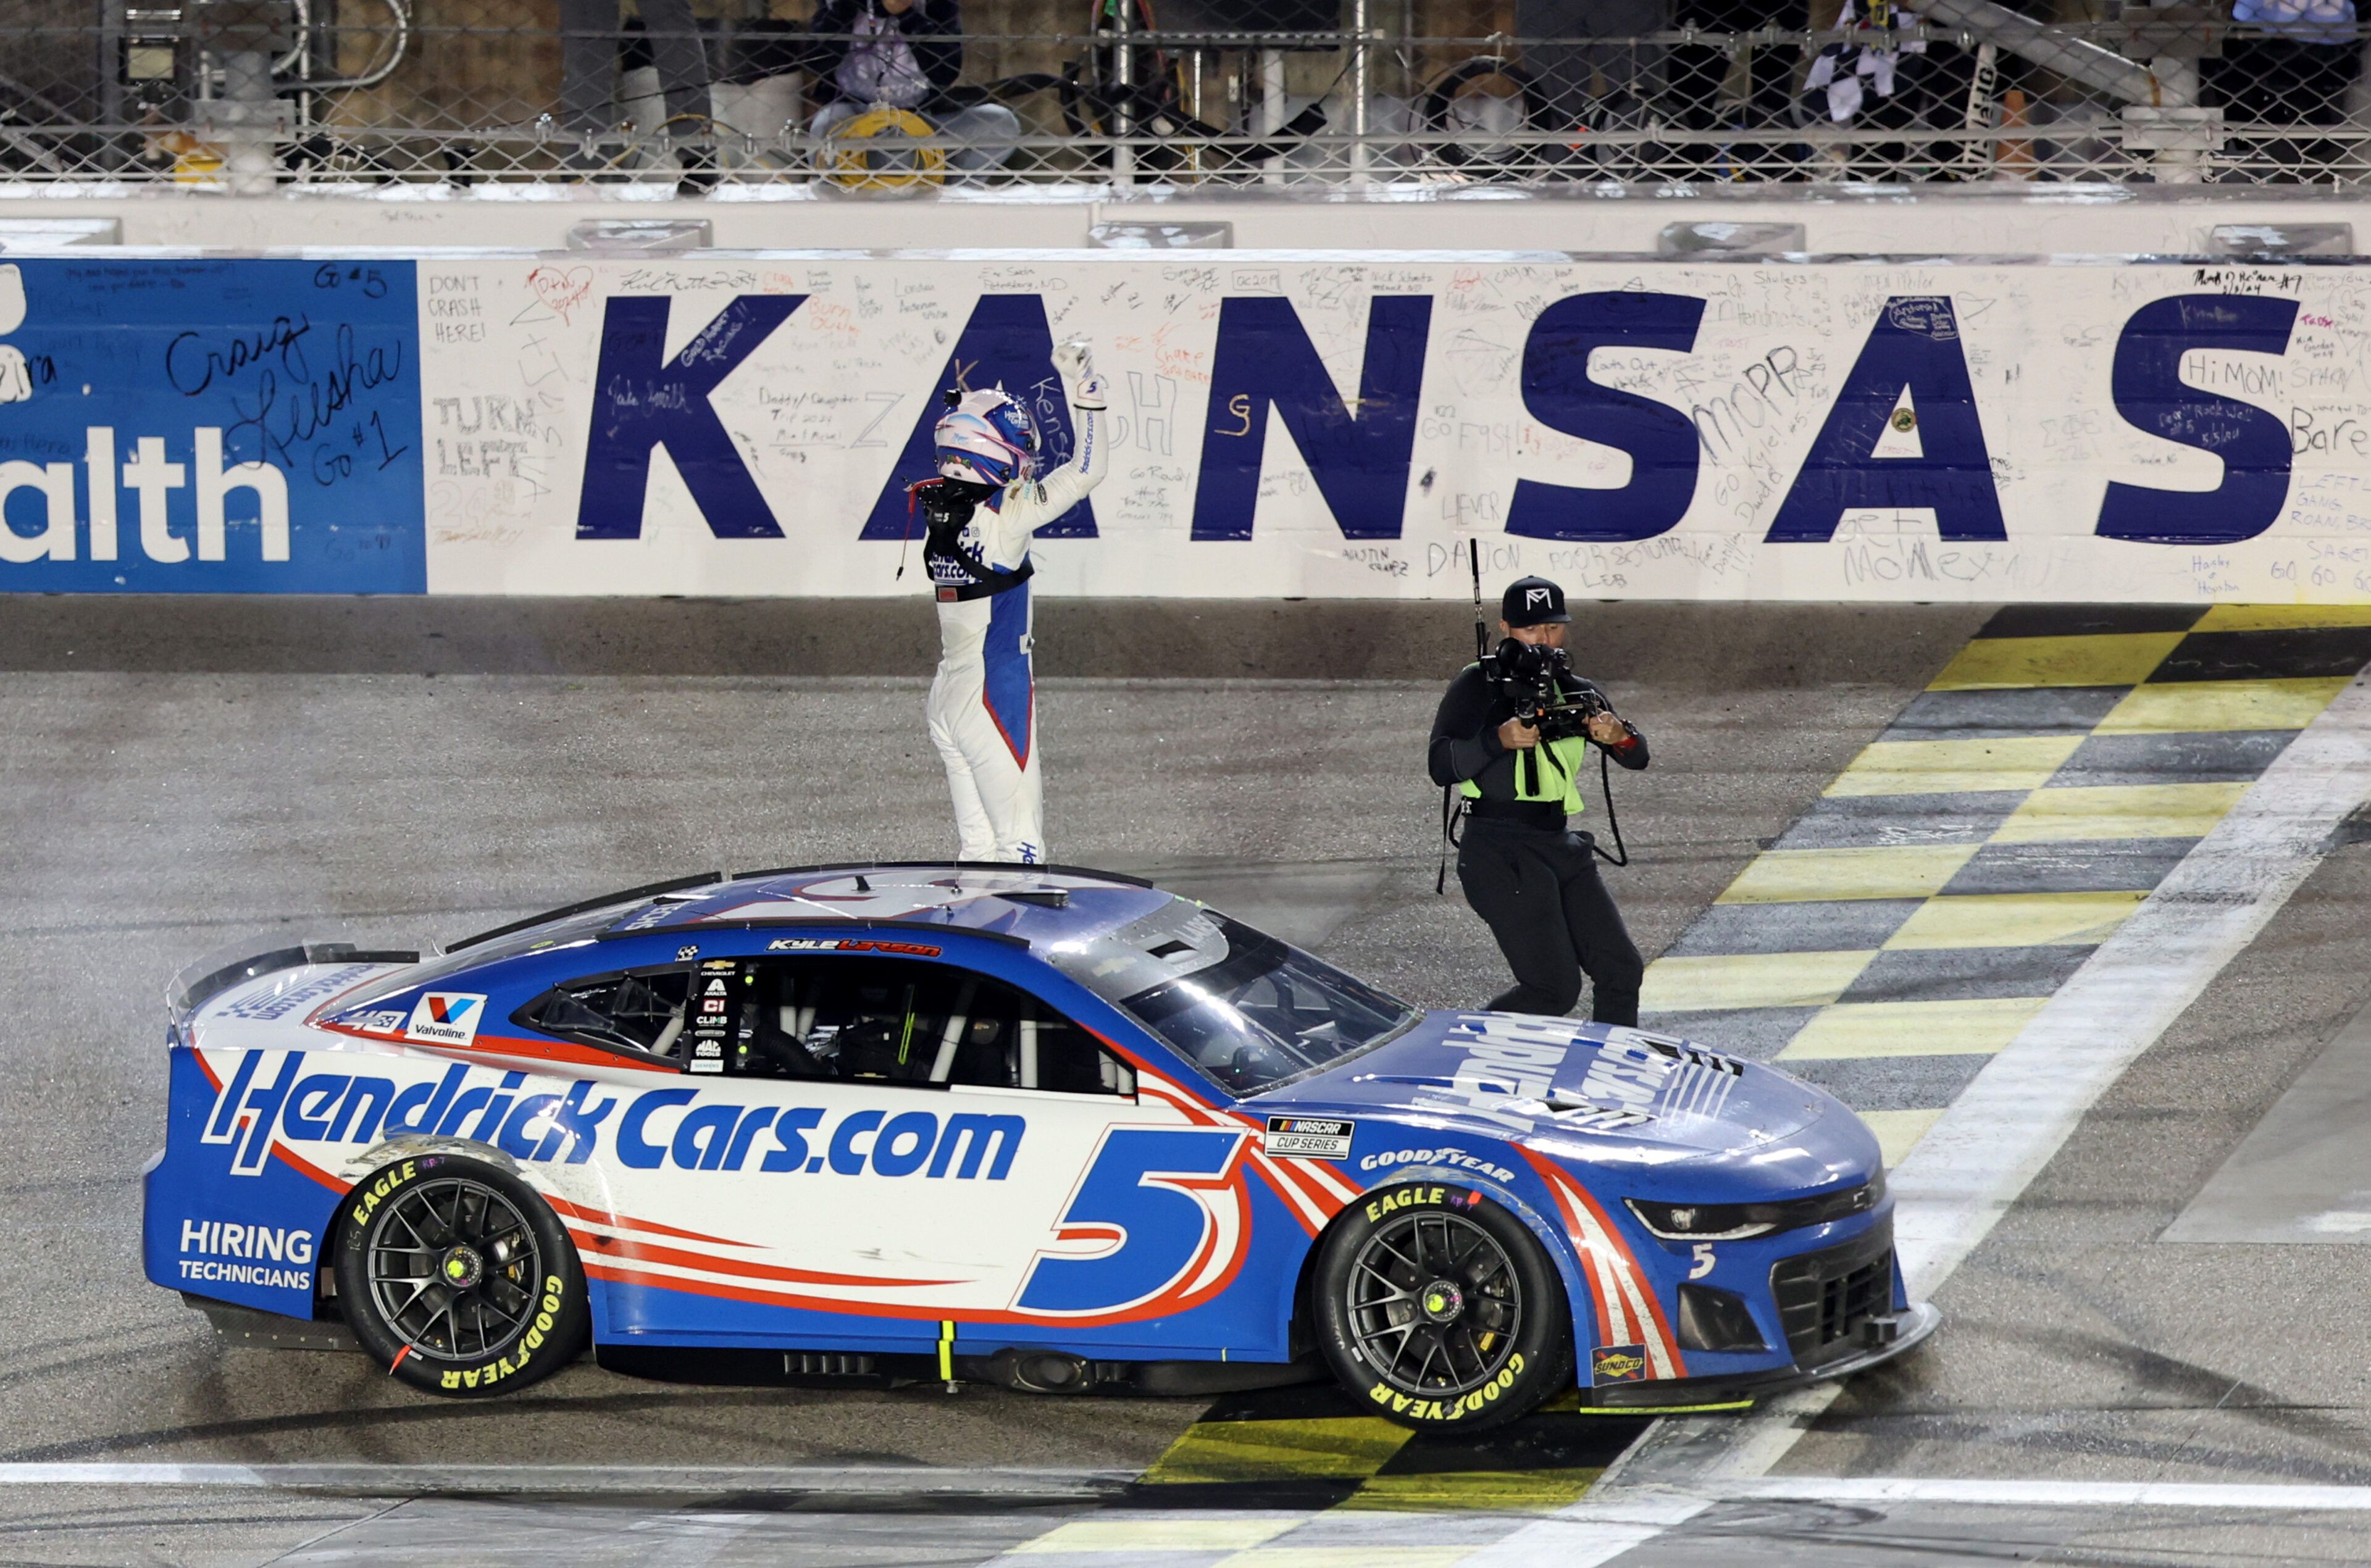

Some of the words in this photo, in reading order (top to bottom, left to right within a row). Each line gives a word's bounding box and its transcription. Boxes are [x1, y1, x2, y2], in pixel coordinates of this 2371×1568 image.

[2188, 354, 2216, 384] Hi
[432, 393, 537, 438] TURN
[575, 292, 2301, 544] KANSAS
[437, 438, 528, 478] LEFT
[0, 426, 290, 564] alth
[415, 1024, 467, 1040] Valvoline
[201, 1049, 1026, 1180] HendrickCars.com
[1292, 1120, 1342, 1135] NASCAR
[1276, 1136, 1299, 1149] CUP
[1300, 1137, 1339, 1151] SERIES
[1359, 1147, 1516, 1183] GOODYEAR
[352, 1161, 417, 1227] EAGLE
[1365, 1187, 1445, 1224] EAGLE
[1008, 1123, 1247, 1317] 5
[180, 1219, 313, 1264] HIRING
[1689, 1242, 1717, 1280] 5
[178, 1259, 311, 1290] TECHNICIANS
[440, 1275, 564, 1389] GOODYEAR
[1369, 1352, 1525, 1420] GOODYEAR
[1595, 1358, 1642, 1375] SUNOCO
